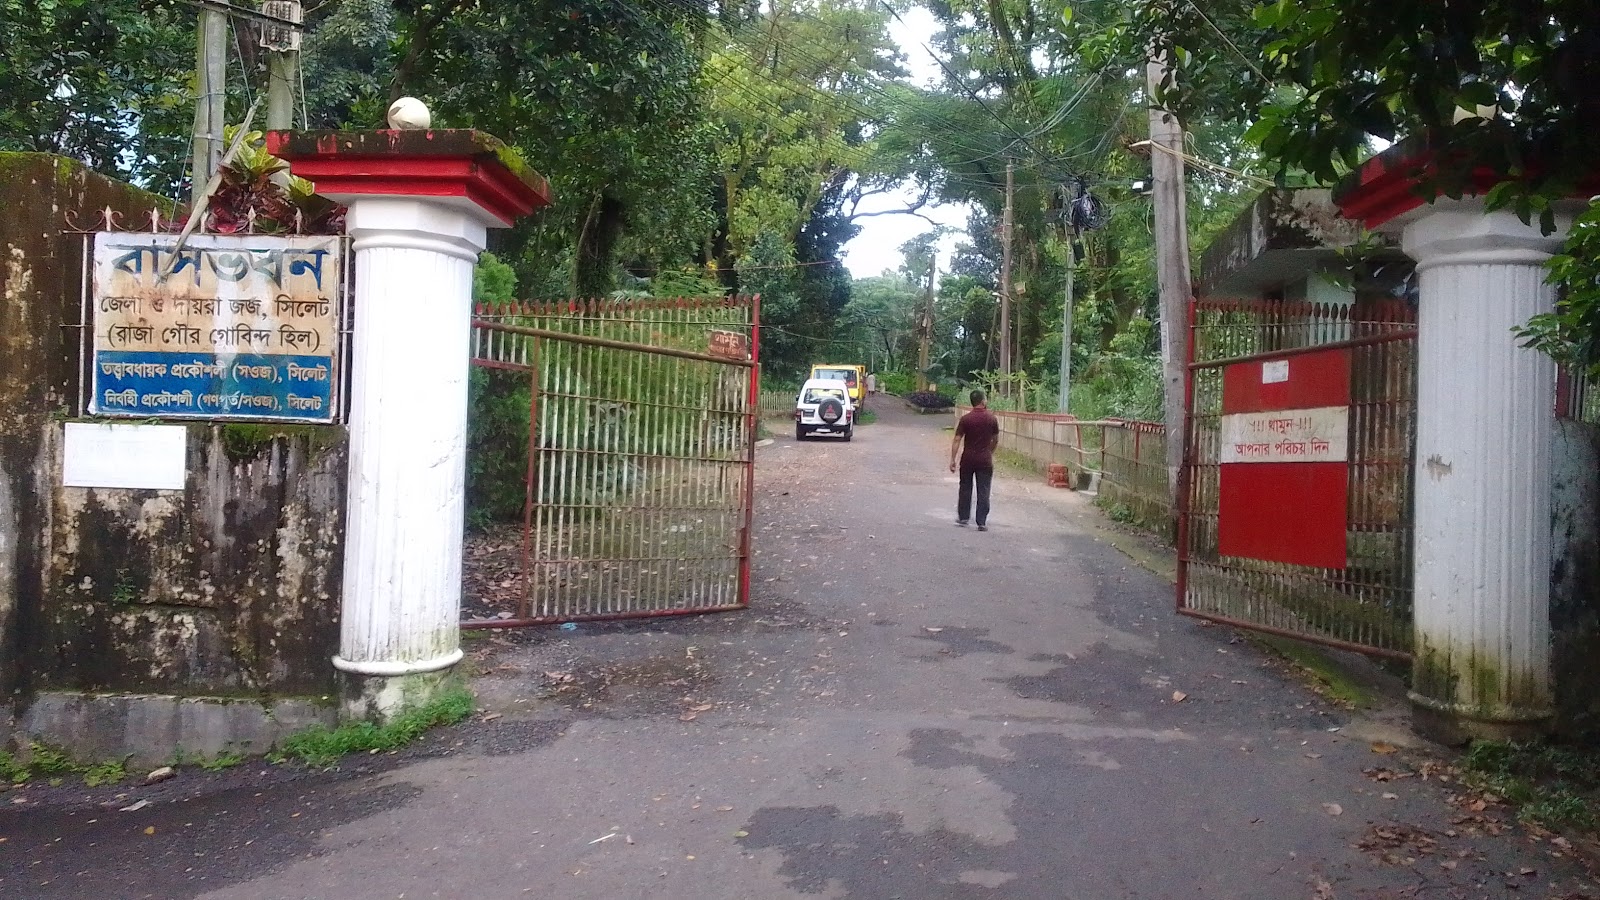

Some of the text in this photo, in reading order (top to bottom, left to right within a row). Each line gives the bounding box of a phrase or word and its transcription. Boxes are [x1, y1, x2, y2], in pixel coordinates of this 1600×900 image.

[106, 243, 329, 290] বাসভবন
[101, 296, 144, 316] জেলা
[152, 297, 164, 314] ও
[171, 296, 222, 317] দায়রা
[274, 294, 331, 319] সিলেট
[107, 320, 321, 354] (রাজা গৌর গোবিন্দ হিল)
[171, 359, 227, 380] প্রকৌশলী
[232, 361, 283, 383] (সওজ),
[287, 361, 328, 382] সিলেট
[141, 389, 193, 409] প্রকৌশলী
[287, 392, 323, 412] সিলেট
[1268, 418, 1294, 435] থামুন
[1234, 436, 1331, 457] আপনার পরিচয় দিন
